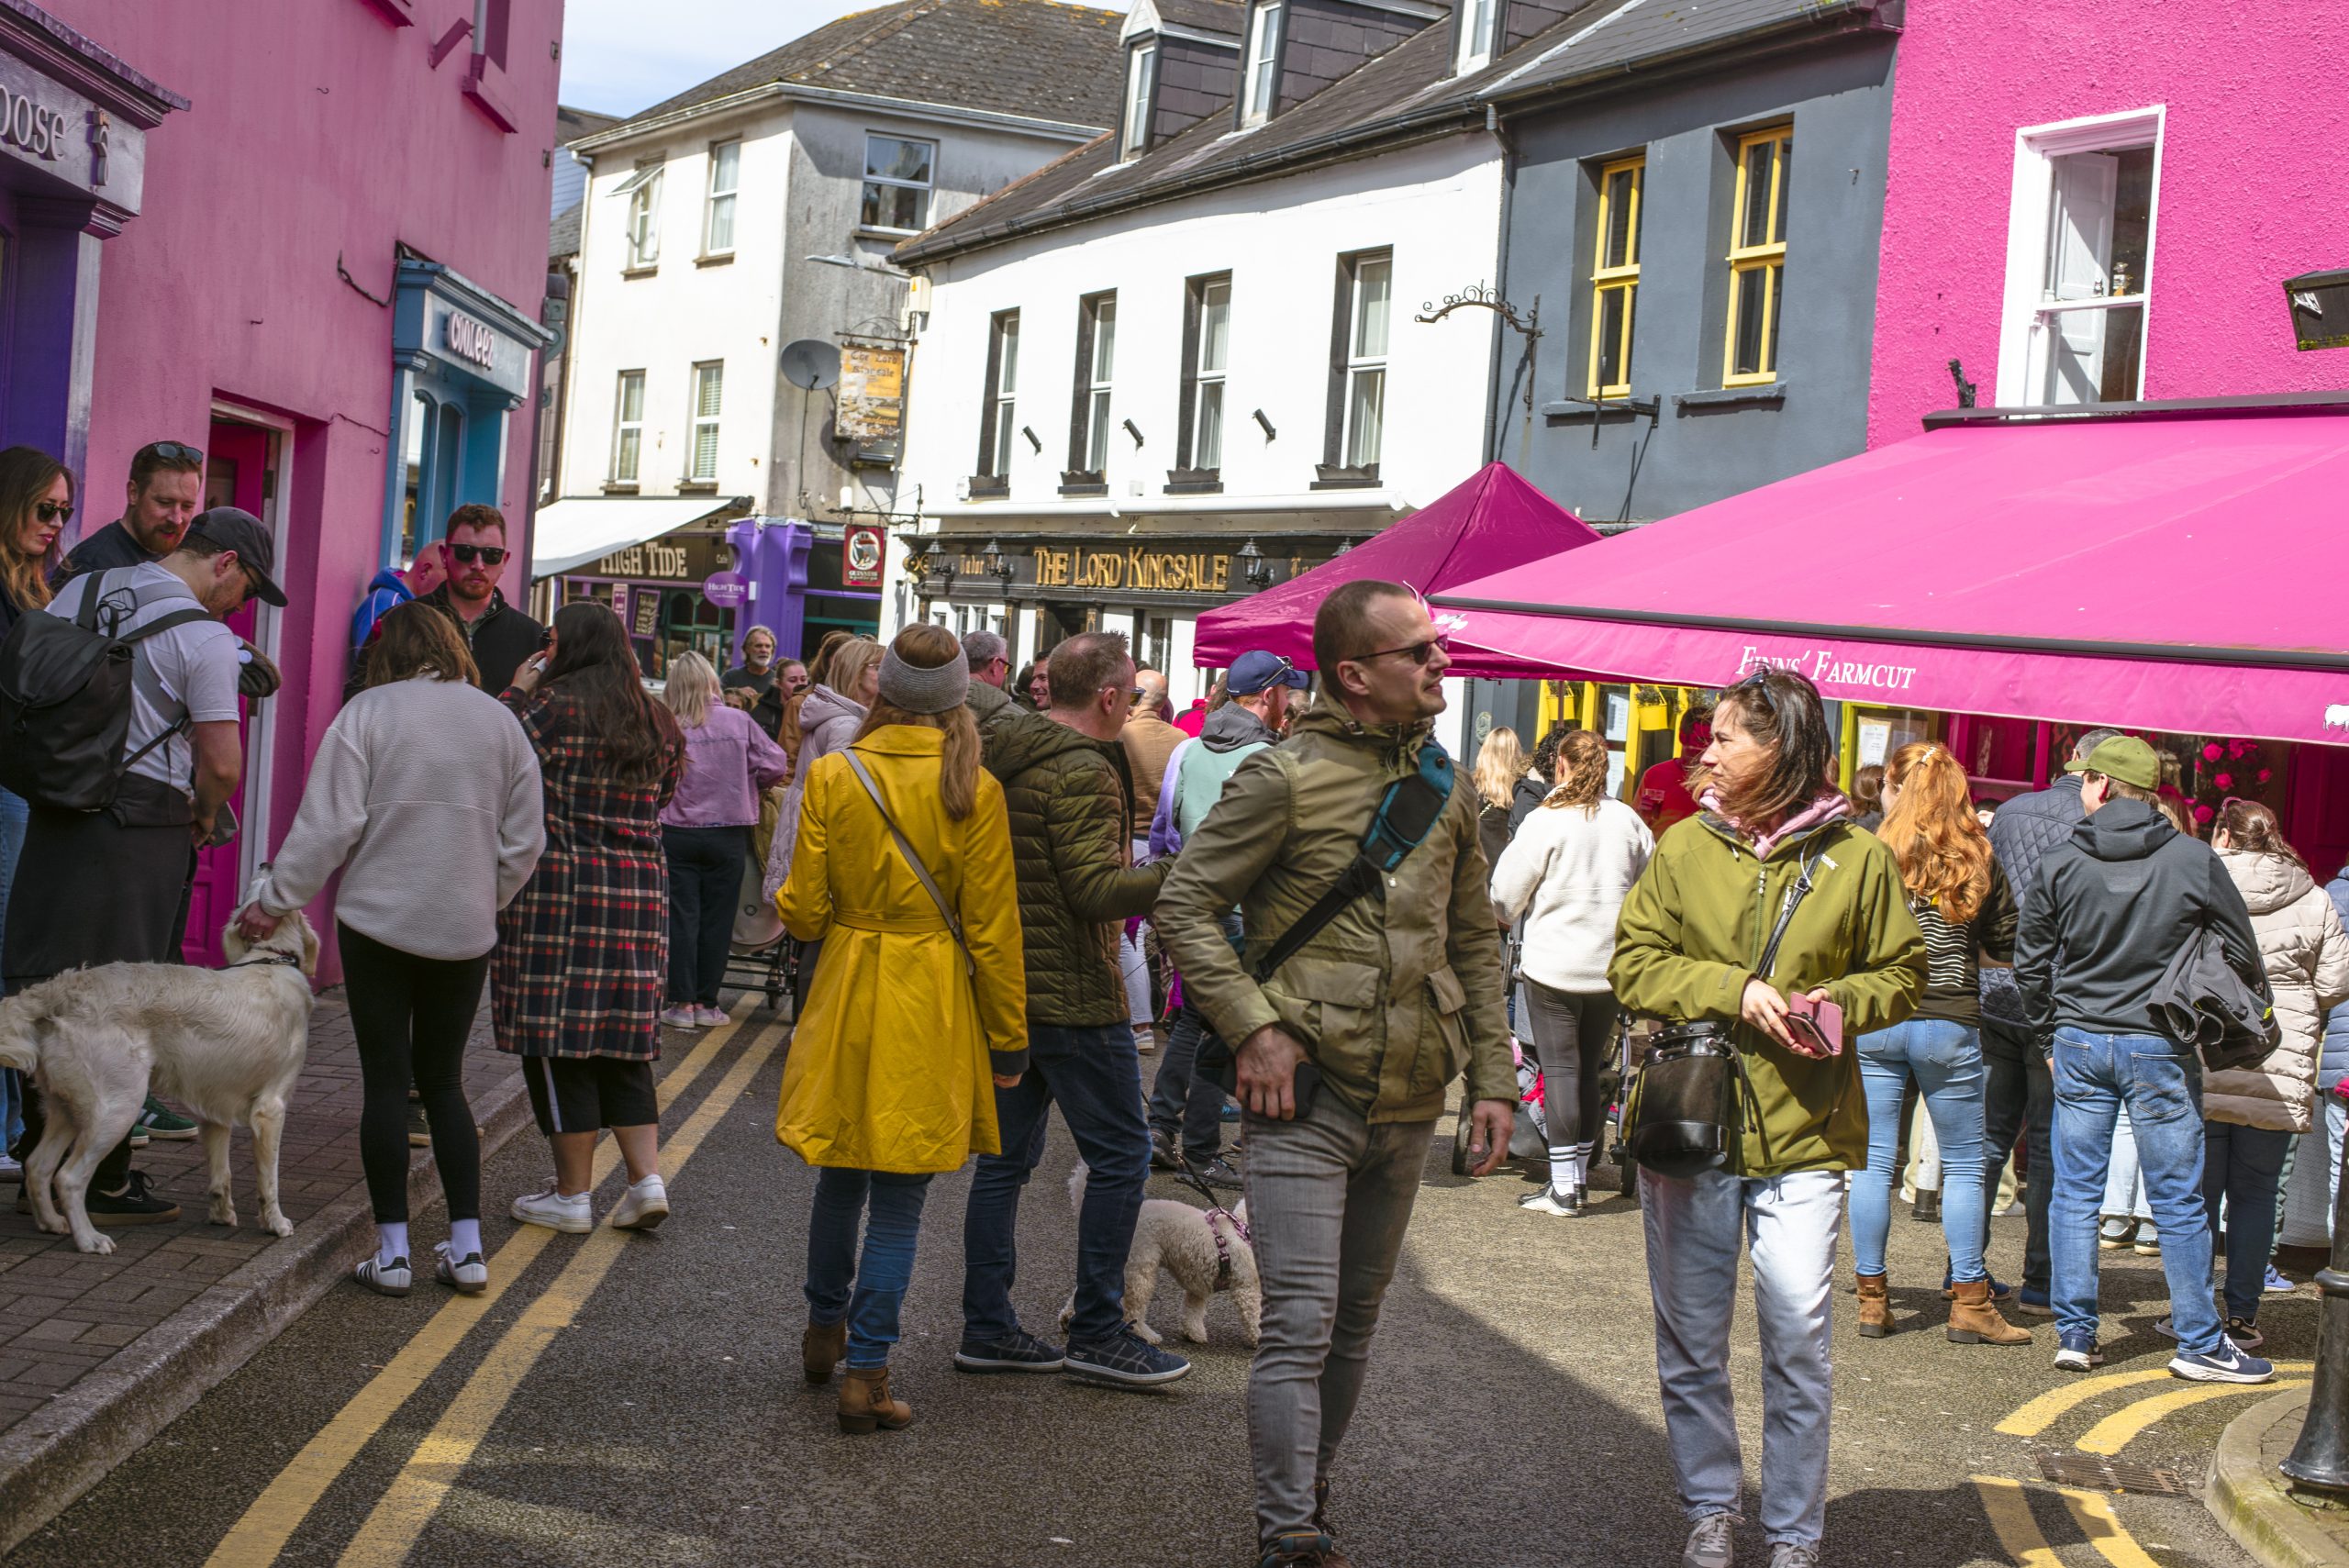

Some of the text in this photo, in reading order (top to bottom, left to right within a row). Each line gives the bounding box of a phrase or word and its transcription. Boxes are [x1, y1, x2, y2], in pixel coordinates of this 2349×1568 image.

[600, 541, 688, 577] HIGH TIDE
[1034, 546, 1230, 592] THE LORD KINGSALE
[1810, 650, 1917, 689] FARMCUT
